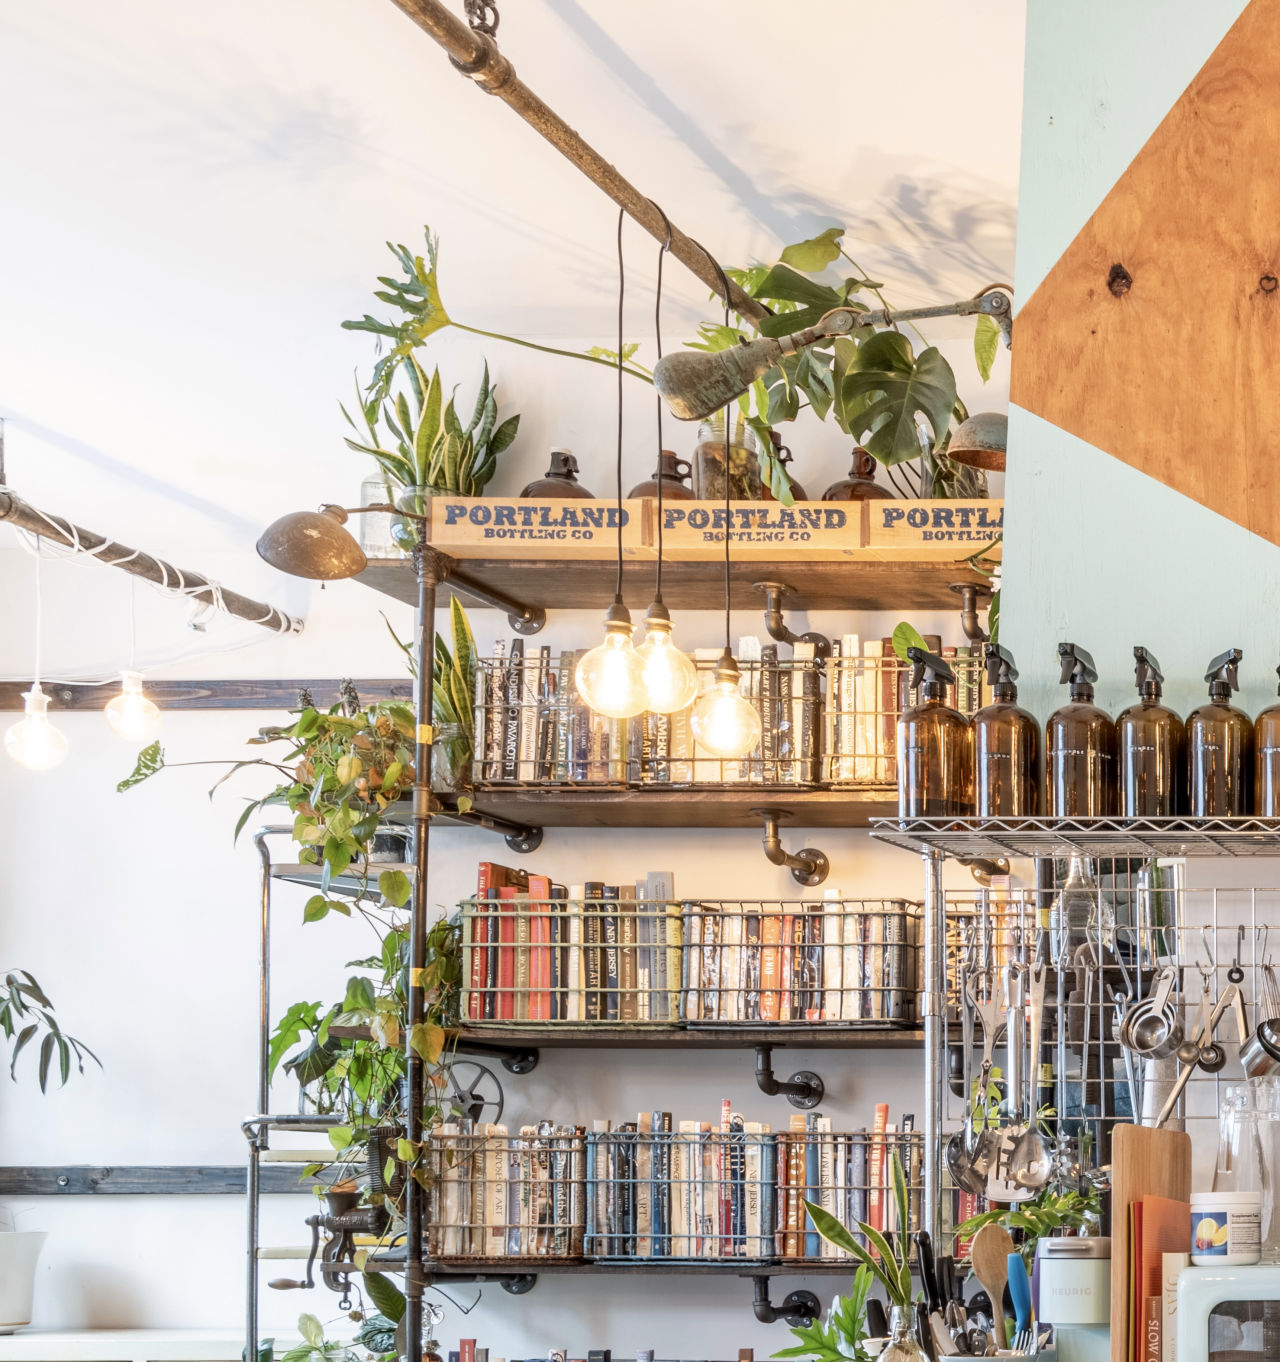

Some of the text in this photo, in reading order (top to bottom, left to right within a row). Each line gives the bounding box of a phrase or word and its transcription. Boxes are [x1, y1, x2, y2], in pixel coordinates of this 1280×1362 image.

[445, 504, 629, 528] PORTLAND
[663, 507, 847, 529] PORTLAND
[484, 528, 594, 540] BOTTLING CO
[703, 531, 811, 542] BOTTLING CO
[560, 669, 569, 687] OW
[762, 691, 771, 729] TROUGH
[504, 720, 519, 771] PAVAROTTI
[622, 917, 633, 955] Atiquities
[607, 947, 616, 978] JERSEY
[875, 1112, 884, 1128] LIFE
[730, 1135, 746, 1174] SHIP
[872, 1150, 880, 1160] TO
[871, 1160, 880, 1175] THE
[495, 1183, 503, 1193] OF
[789, 1143, 807, 1227] RODIN
[821, 1151, 830, 1206] LONG ISLAND
[495, 1196, 503, 1216] ART
[556, 1201, 567, 1215] the
[749, 1190, 758, 1217] JERSEY
[556, 1216, 568, 1235] Sa
[1052, 1287, 1092, 1297] KEURIG
[1147, 1319, 1159, 1353] SLOW
